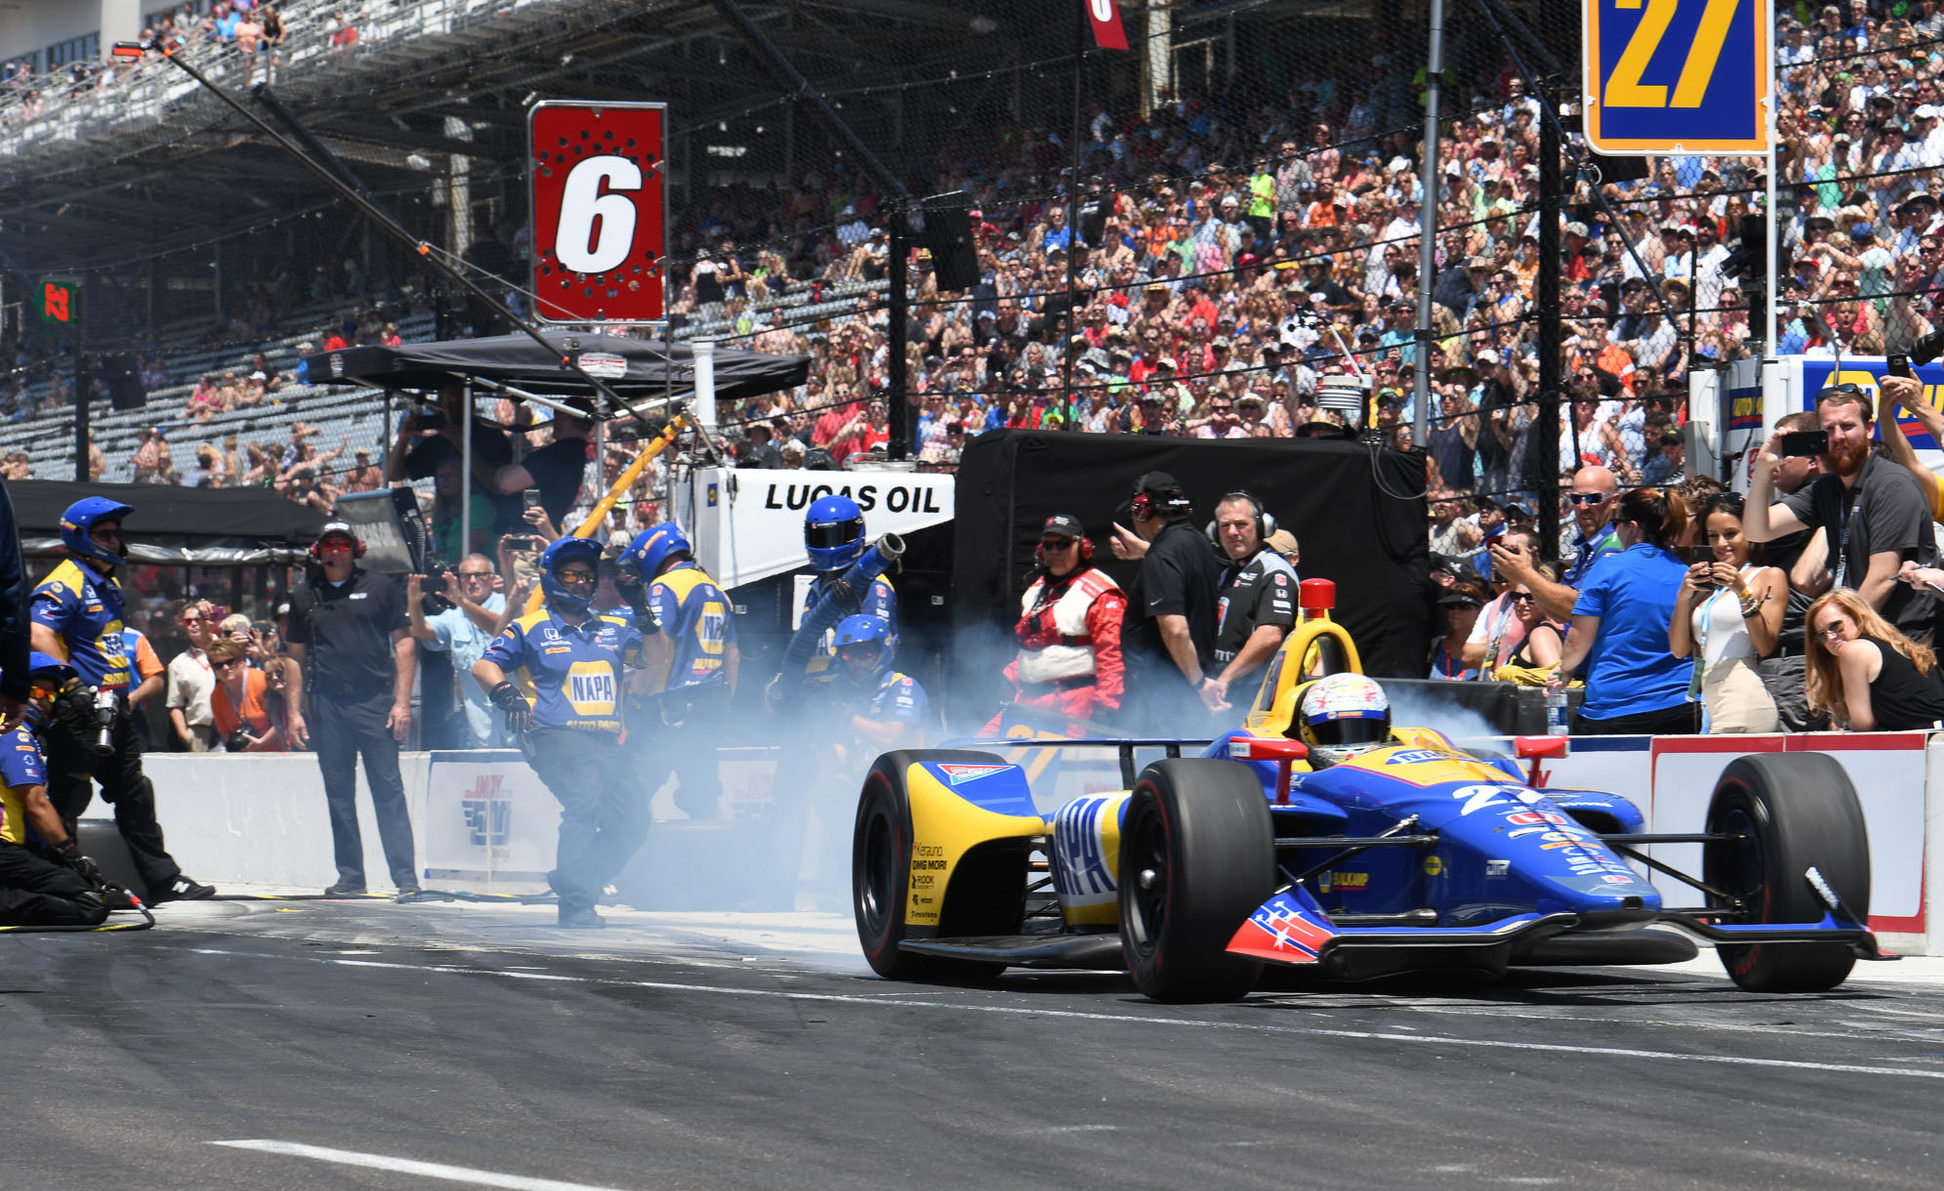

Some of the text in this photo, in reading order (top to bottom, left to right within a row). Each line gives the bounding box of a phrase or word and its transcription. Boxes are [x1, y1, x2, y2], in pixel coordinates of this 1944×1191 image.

[1603, 0, 1739, 108] 27
[555, 154, 642, 274] 6
[887, 486, 940, 513] OIL
[572, 675, 614, 702] NAPA
[1453, 785, 1545, 817] 27
